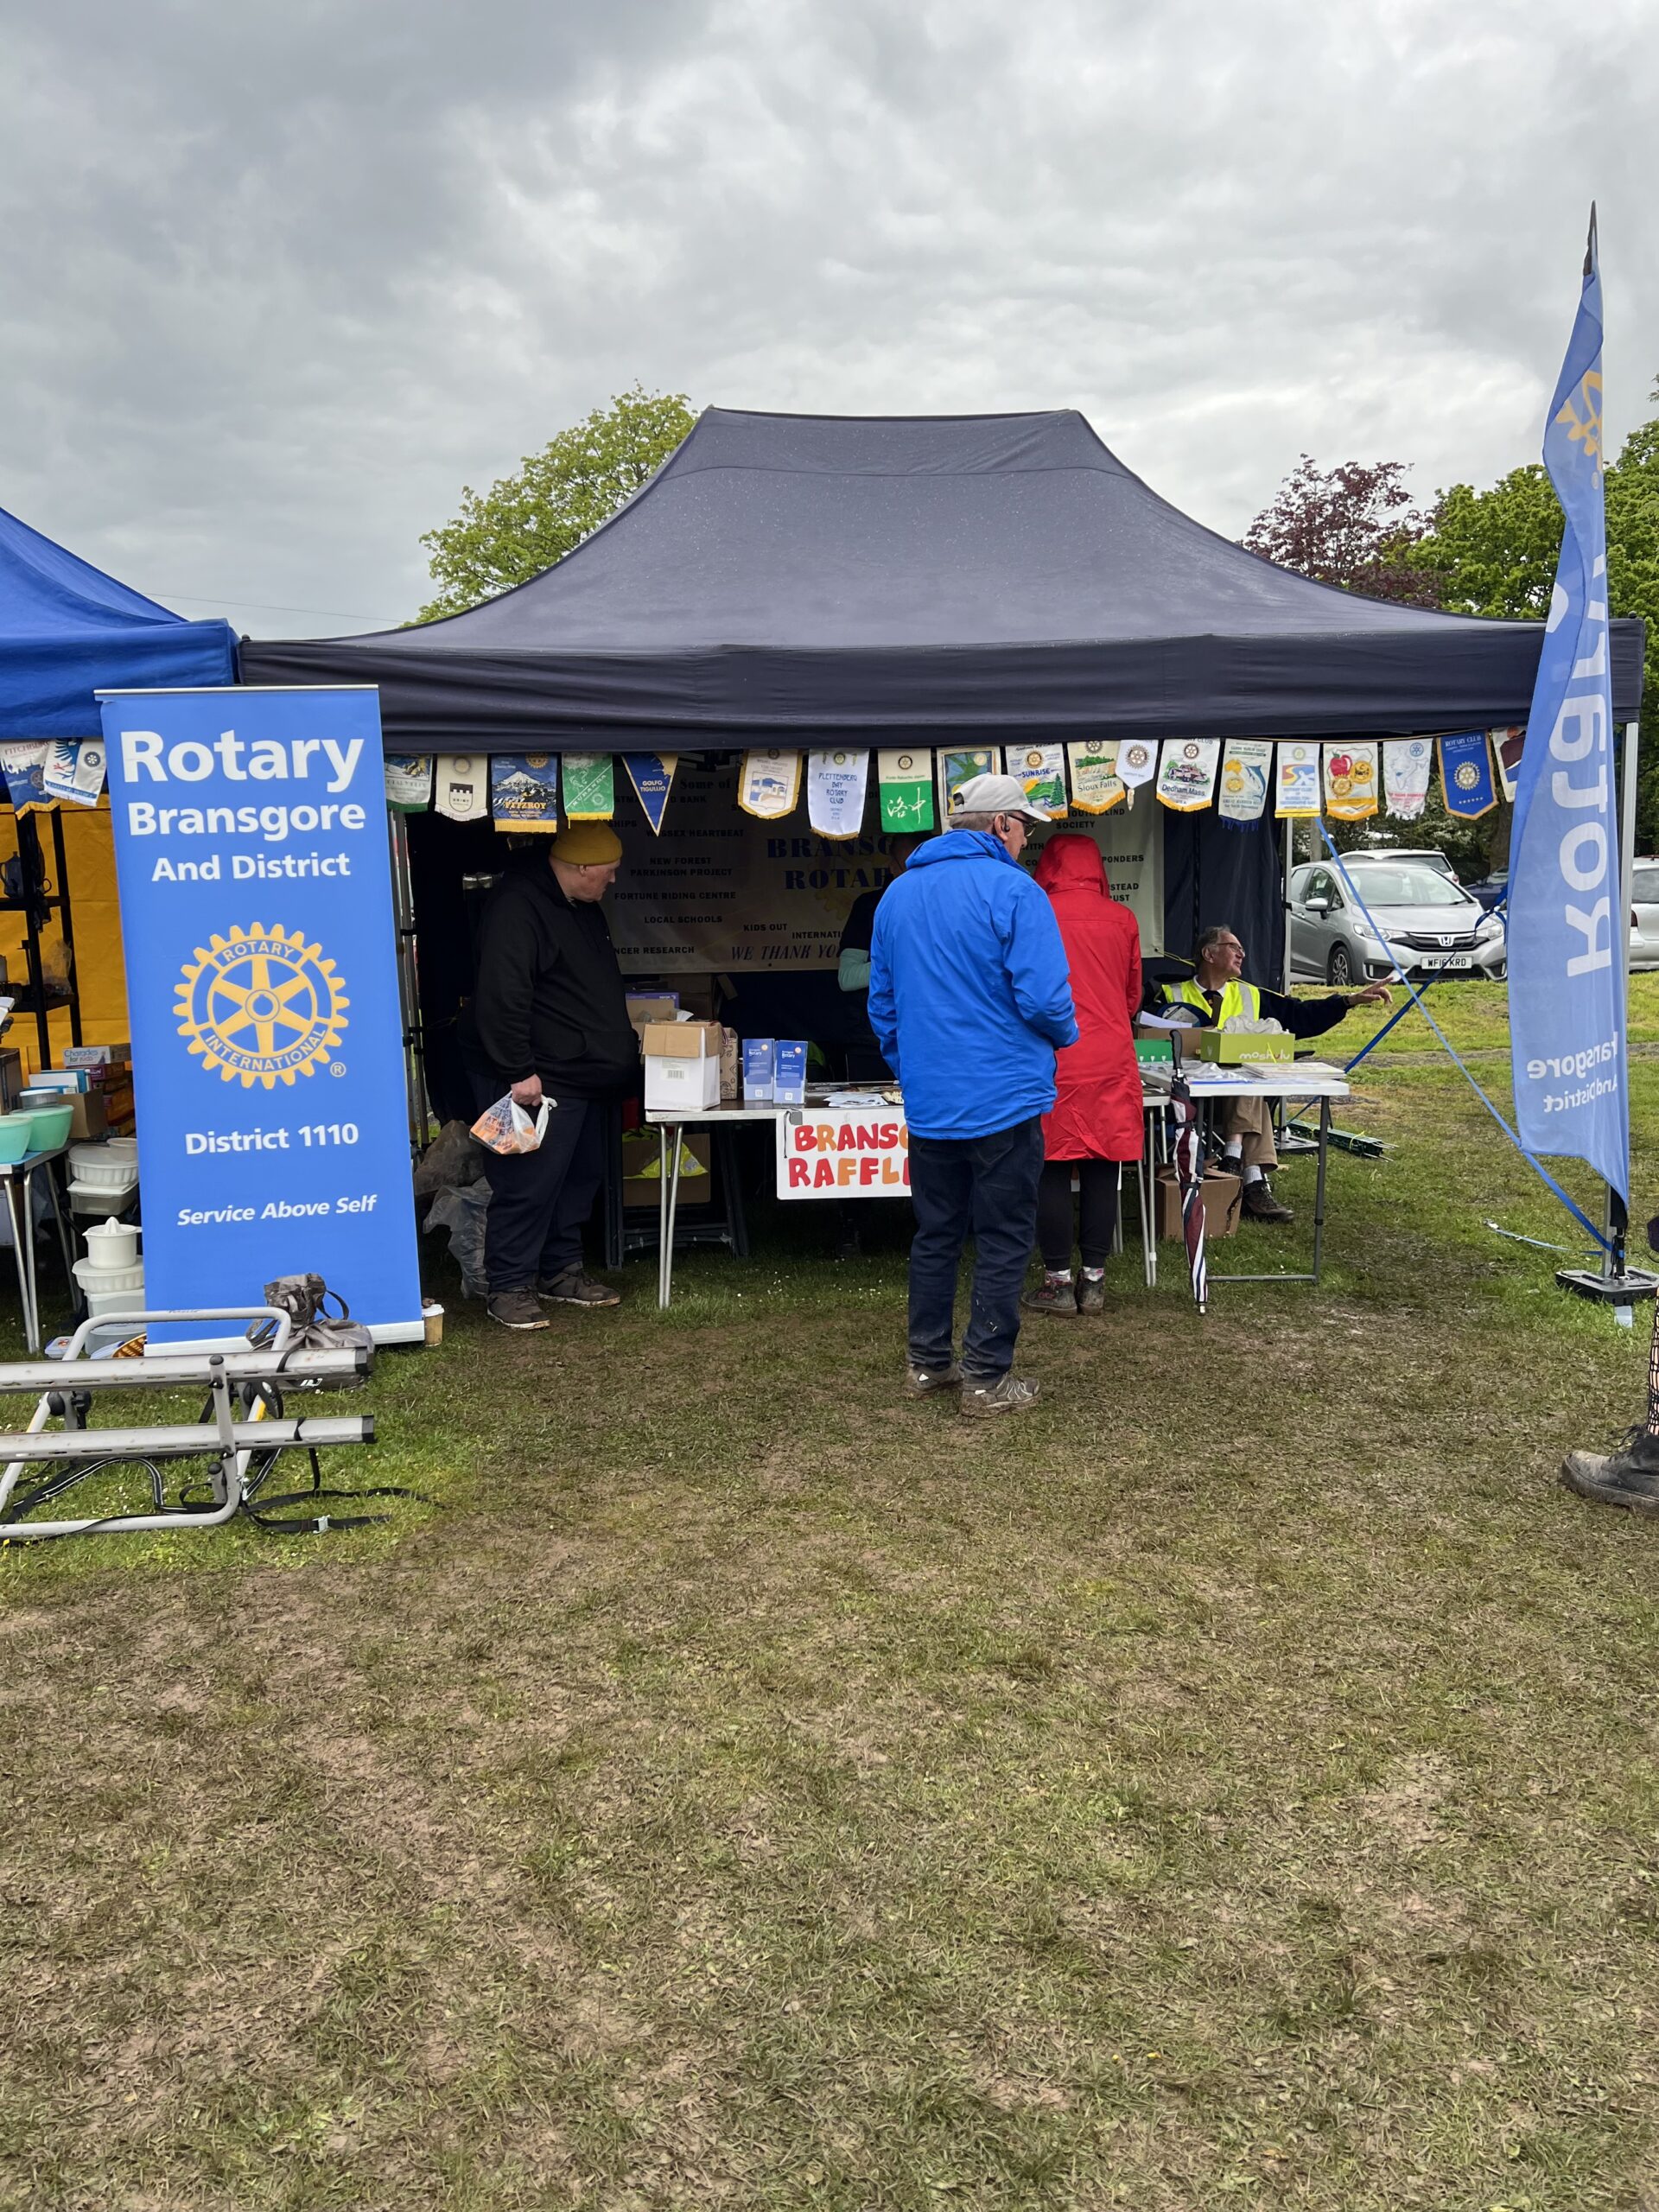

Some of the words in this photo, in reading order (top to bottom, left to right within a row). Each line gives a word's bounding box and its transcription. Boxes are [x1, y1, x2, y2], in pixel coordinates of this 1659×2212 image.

[121, 729, 364, 793] Rotary
[1021, 768, 1051, 778] SUNRISE
[1077, 784, 1098, 792] Sioux
[128, 802, 366, 842] Bransgore
[1056, 821, 1096, 830] SOCIETY
[690, 829, 744, 837] HEARTBEAT
[1102, 855, 1144, 863] PONDERS
[151, 855, 220, 881] And
[232, 852, 351, 880] District
[631, 868, 687, 877] PARKINSON
[792, 931, 842, 939] INTERNATI
[222, 940, 295, 963] ROTARY
[732, 946, 753, 961] WE
[761, 944, 811, 960] THANK
[1450, 957, 1466, 967] KRD
[205, 1028, 327, 1071] INTERNATIONAL
[1239, 1048, 1290, 1061] moshulu
[185, 1128, 289, 1155] District
[298, 1122, 359, 1147] 1110
[177, 1205, 255, 1226] Service
[261, 1200, 330, 1220] Above
[335, 1194, 378, 1213] Self
